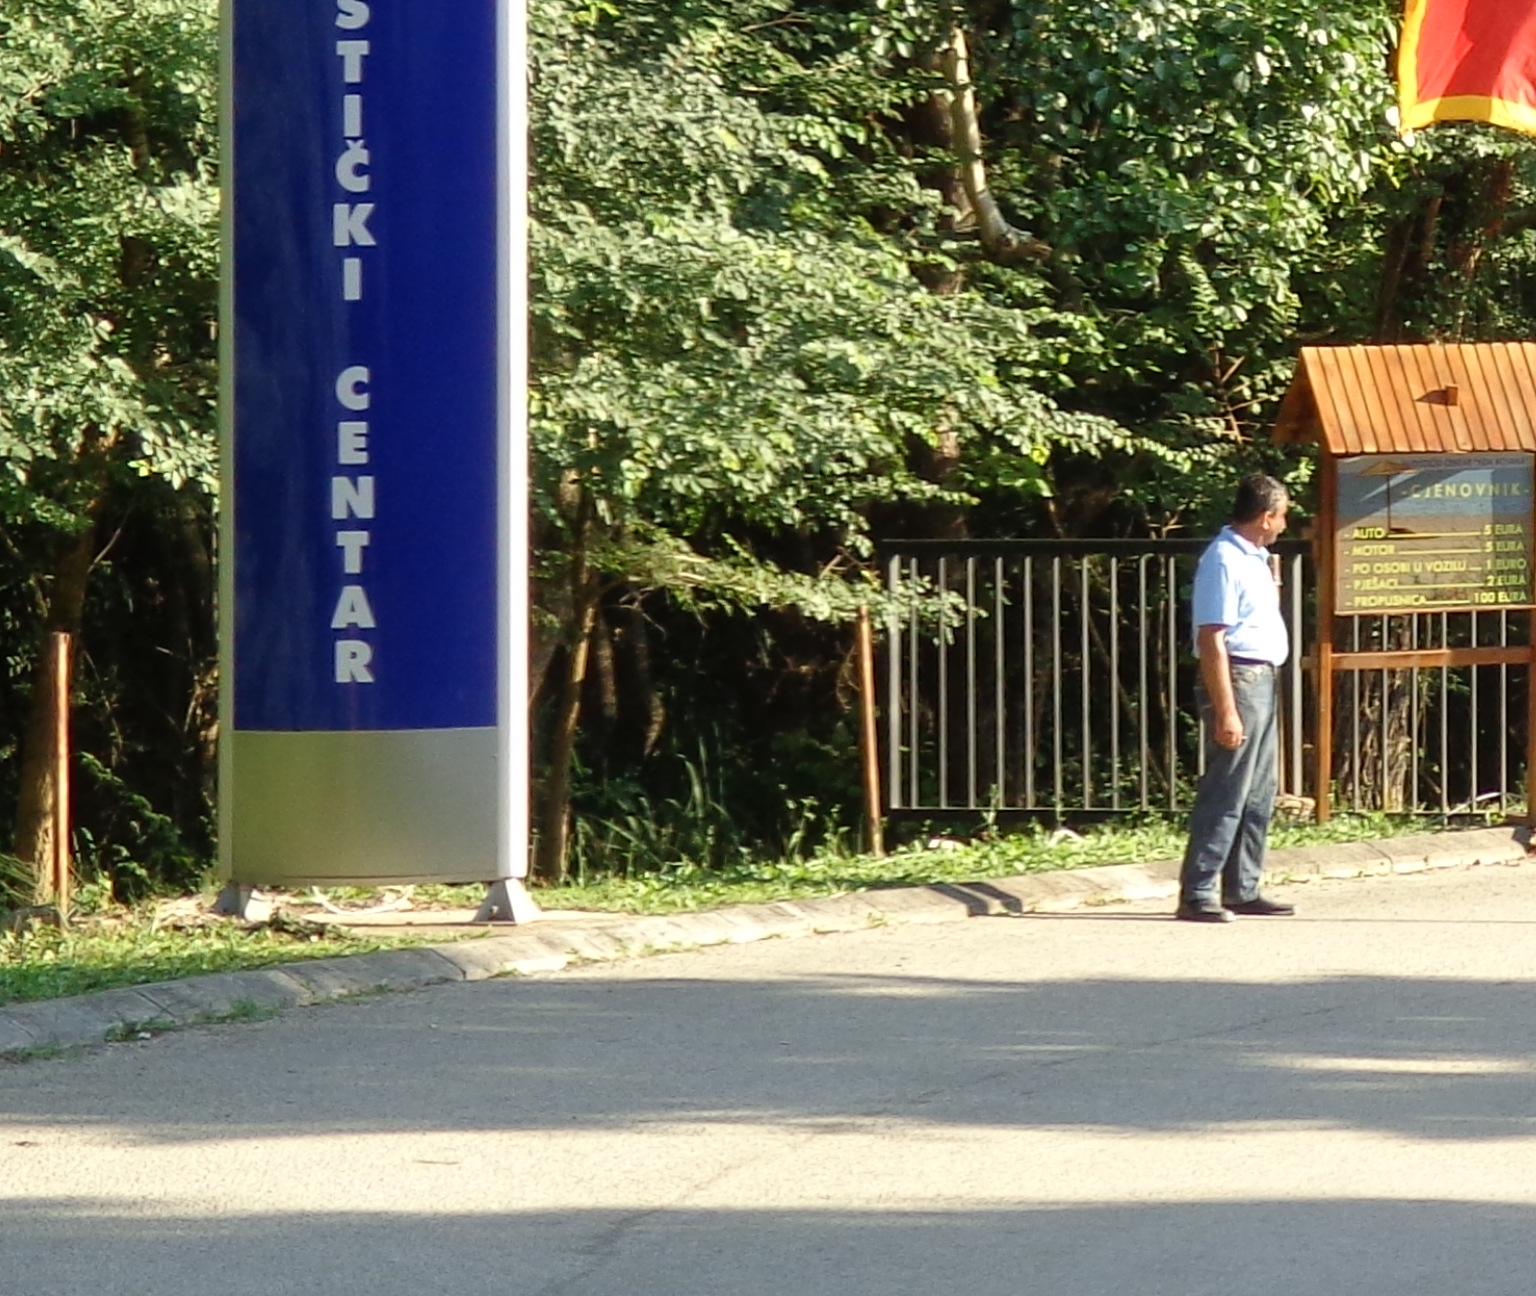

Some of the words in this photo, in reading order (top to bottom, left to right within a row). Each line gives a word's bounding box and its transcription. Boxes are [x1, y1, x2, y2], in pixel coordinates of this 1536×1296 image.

[330, 365, 375, 684] CENTAR
[1352, 528, 1386, 539] AUTO
[1495, 524, 1522, 535] EURA
[1352, 545, 1395, 556] MOTOR
[1496, 541, 1524, 552] EURA
[1352, 563, 1370, 574] PO
[1373, 562, 1410, 573] OSOBI
[1413, 562, 1422, 572] U
[1425, 561, 1467, 572] VOZILU
[1496, 558, 1527, 569] EURO
[1486, 576, 1494, 586] 2
[1497, 575, 1526, 586] EURA
[1354, 595, 1427, 606] PROPUSNICA
[1473, 593, 1495, 603] 100
[1498, 592, 1527, 603] EURA
